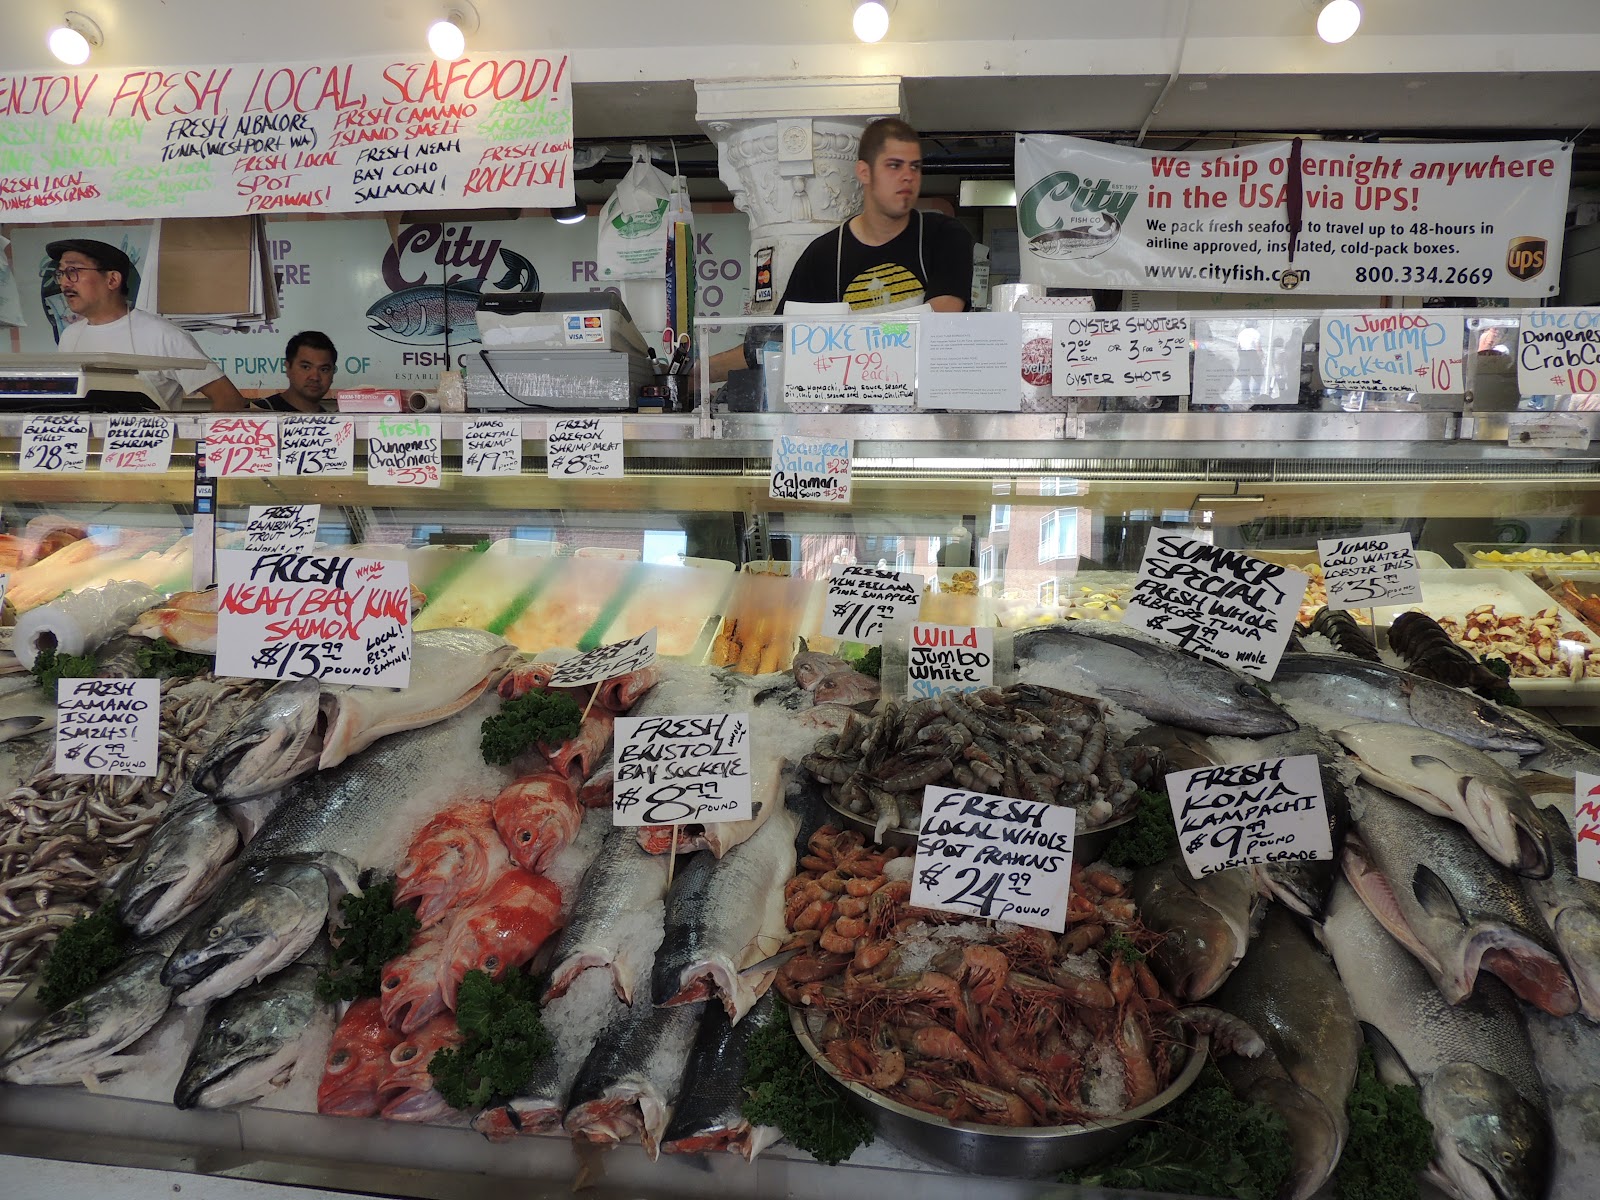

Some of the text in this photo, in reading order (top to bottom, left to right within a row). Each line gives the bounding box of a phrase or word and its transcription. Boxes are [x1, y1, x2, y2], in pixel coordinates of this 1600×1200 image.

[243, 64, 367, 113] LOCAL,
[383, 56, 568, 105] SEAFOOD!
[167, 114, 314, 140] FRESH ALBACORE
[334, 103, 478, 131] FRESH CAMANO
[328, 120, 465, 150] ISLAND SMELT
[355, 139, 461, 166] FRESH NEAH
[479, 139, 573, 165] FRESH LOCAL
[232, 151, 343, 175] FRESH LOCAL
[1151, 154, 1555, 186] We ship oernight anywhere
[43, 171, 91, 193] LOCAL
[353, 162, 438, 185] BAY COHO
[463, 154, 568, 197] ROCKFISH
[237, 174, 303, 195] SPOT
[355, 175, 447, 205] SALMON!
[246, 186, 332, 212] PRAWNS!
[1019, 170, 1139, 240] City
[1148, 185, 1420, 211] in the via UPS!
[1071, 216, 1087, 224] FISH
[1146, 219, 1494, 239] We pack fresh to travel up to 48-hours in
[1146, 238, 1460, 257] airline approved, inslated, cold-pack boxes.
[382, 223, 502, 293] City
[1509, 250, 1544, 274] ups
[1145, 263, 1493, 285] www.cityfish.cm 800.334.2669
[758, 289, 771, 299] VISA
[1068, 316, 1187, 335] OYSTER SHOOTERS
[1354, 314, 1430, 333] Jumbo
[1530, 310, 1570, 329] the
[792, 323, 856, 355] POKE
[1326, 319, 1446, 363] Shrimp
[1108, 344, 1121, 353] OR
[1128, 339, 1140, 360] 3
[345, 357, 371, 374] OF
[1024, 363, 1048, 374] yelp
[1325, 351, 1414, 381] Cocktail
[1066, 370, 1172, 386] OYSTER SHOTS
[32, 415, 80, 425] FRESH
[209, 418, 270, 438] BAY
[378, 416, 430, 438] fresh
[468, 420, 504, 430] JUMBO
[555, 419, 601, 431] FRESH
[205, 433, 277, 447] SCALLOPS
[284, 426, 331, 438] WHITE
[466, 428, 520, 439] COCKTAIL
[549, 429, 605, 443] OREGON
[109, 439, 164, 450] SHRIMP
[282, 438, 333, 450] SHRIMP
[369, 438, 438, 454] Dungeness
[468, 438, 512, 450] SHRIMP
[549, 442, 622, 455] SHRIMP MEAT
[776, 435, 849, 459] Seaweed
[322, 461, 348, 473] POUND
[775, 455, 826, 474] Salad
[773, 471, 838, 490] Calamari
[772, 486, 799, 500] Salad
[259, 504, 305, 522] FRESH
[247, 520, 295, 531] RAINBOW
[249, 532, 286, 543] TROUT
[1323, 548, 1414, 568] COLD WATER
[1327, 540, 1389, 556] JUMBO
[250, 554, 386, 590] FRESH WHOLE
[842, 567, 901, 581] FRESH
[1157, 536, 1285, 592] SUMMER
[1324, 559, 1414, 580] LOBSTER TAILS
[829, 577, 856, 586] NEW
[829, 587, 858, 596] PINK
[1387, 585, 1416, 598] POUND
[218, 583, 409, 626] NEAH BAY KING
[1134, 579, 1279, 634] FRESH WHOLE
[1129, 593, 1262, 642] ALBACORE TUNA
[264, 617, 366, 642] SALMON
[366, 623, 405, 651] LOCAL!
[911, 647, 990, 668] Jumbo
[1192, 642, 1230, 659] POUND
[319, 647, 412, 679] POUND EATING!
[909, 664, 980, 682] White
[73, 680, 137, 697] FRESH
[58, 698, 149, 712] CAMANO
[60, 712, 139, 724] ISLAND
[59, 725, 138, 742] SMELTS!
[630, 714, 729, 743] FRESH
[618, 738, 739, 763] BRISTOL
[108, 760, 147, 771] POUND
[614, 758, 748, 784] BAY SOCKEYE
[1185, 758, 1286, 793] FRESH
[695, 800, 738, 819] POUND
[934, 793, 1050, 828] FRESH
[1180, 782, 1300, 820] KONA
[1180, 795, 1318, 836] KAMPACHI
[921, 816, 1072, 853] LOCAL WHOLE
[1247, 834, 1295, 854] POUND
[917, 838, 1065, 873] SPOT PRAWNS
[1201, 850, 1318, 875] SUSHI GRADE
[998, 903, 1050, 919] POUND
